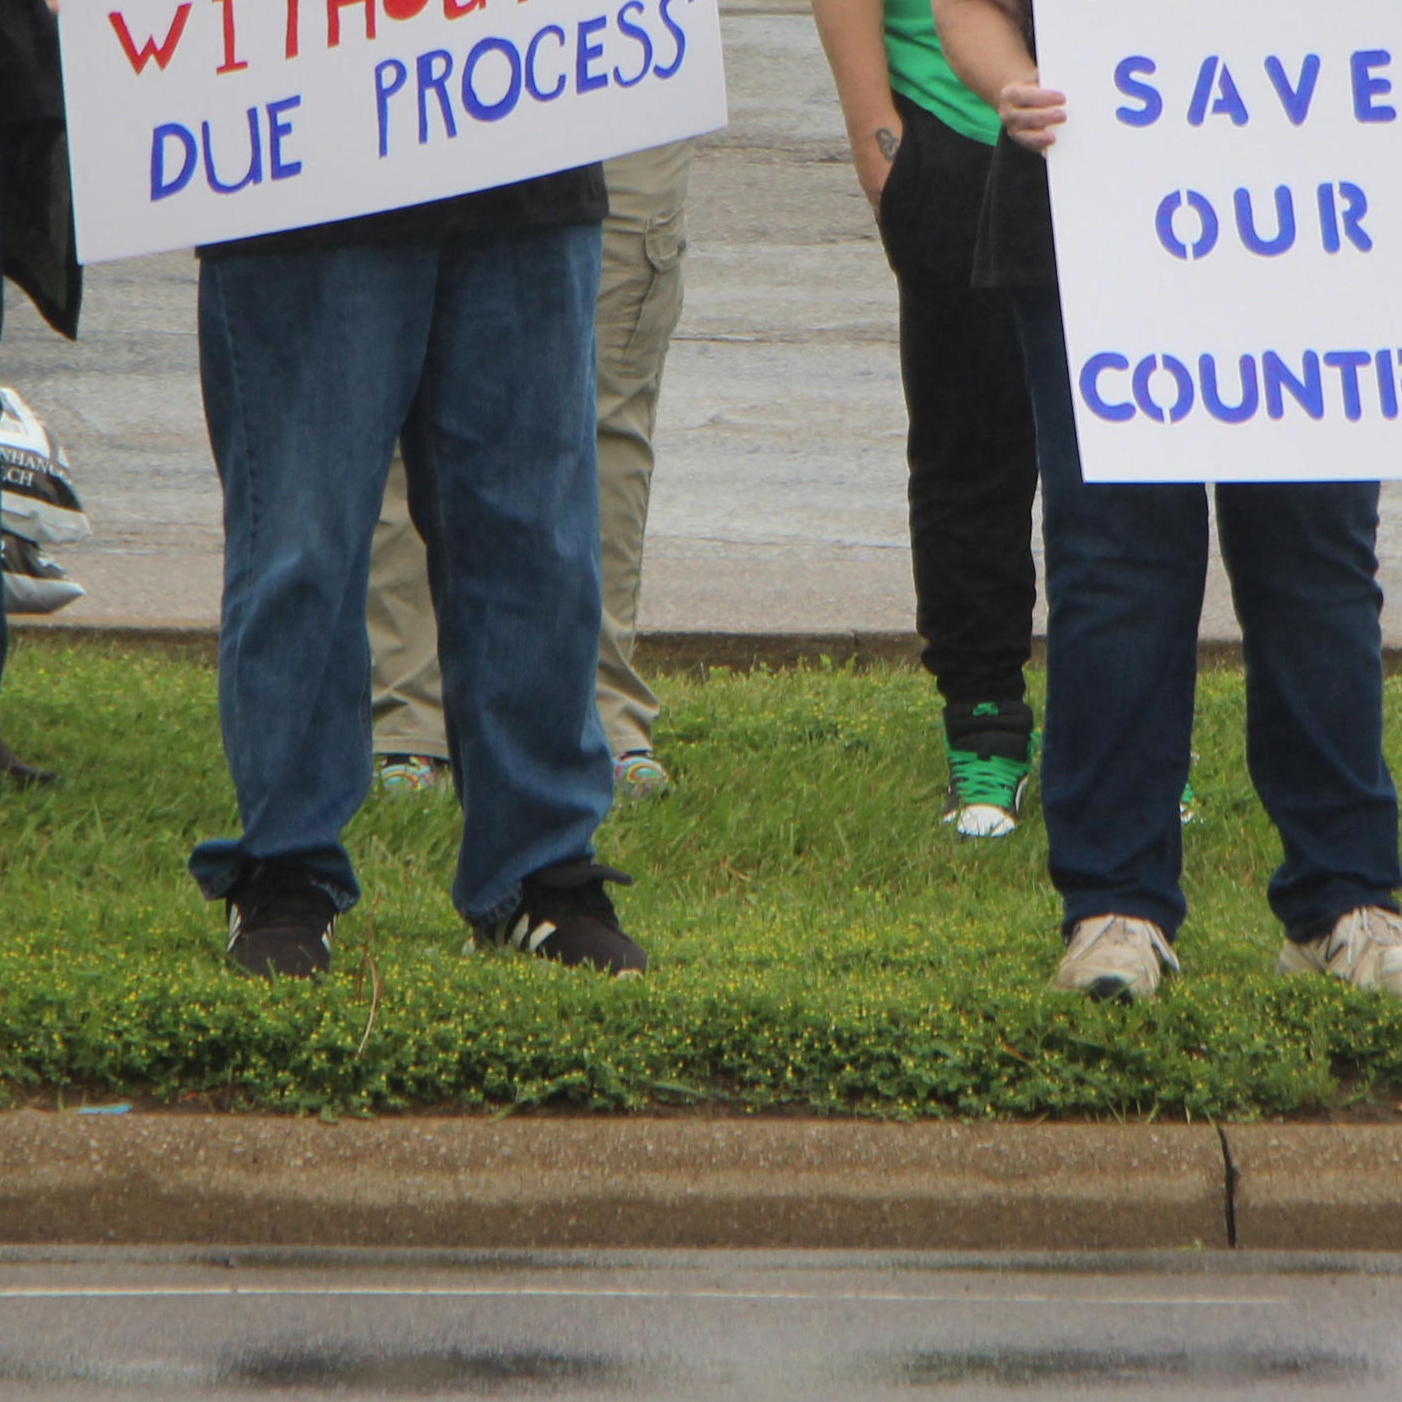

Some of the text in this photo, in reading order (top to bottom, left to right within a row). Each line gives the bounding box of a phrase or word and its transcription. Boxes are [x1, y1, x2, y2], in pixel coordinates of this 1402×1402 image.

[1115, 48, 1397, 128] SAVE
[150, 94, 303, 203] DUE
[1155, 180, 1373, 261] OUR
